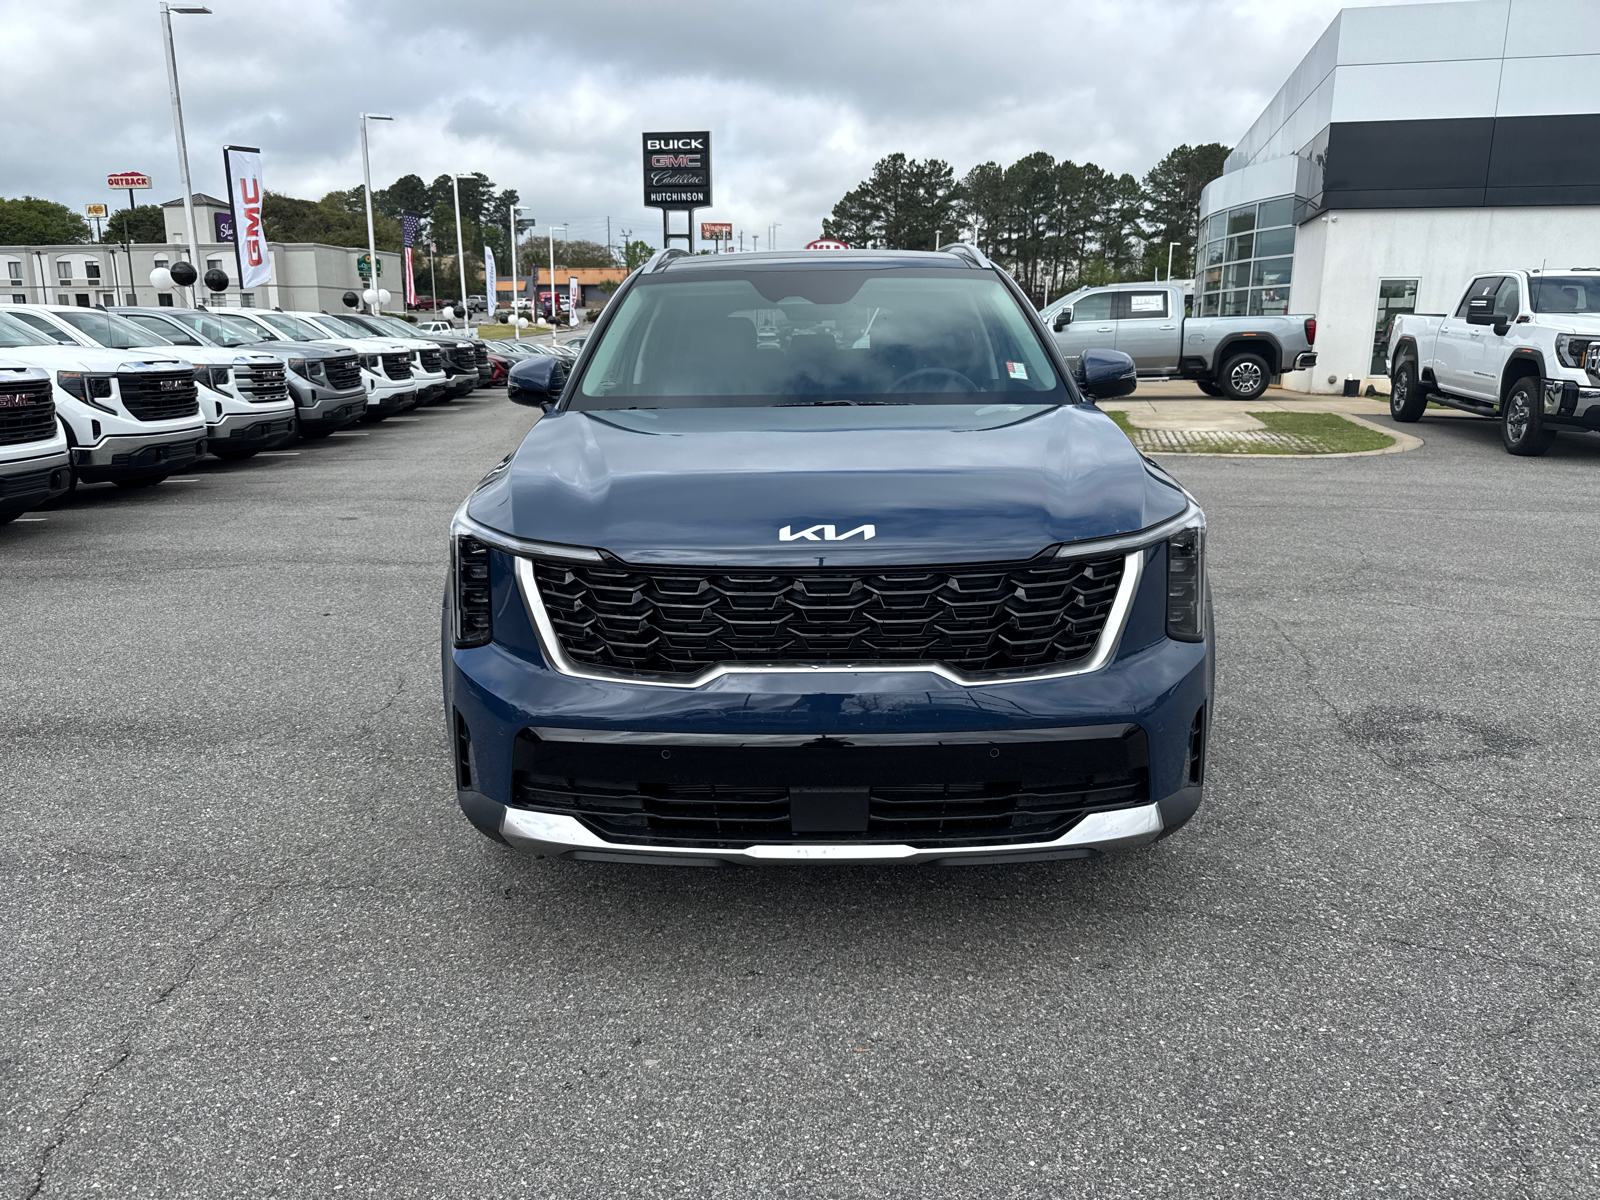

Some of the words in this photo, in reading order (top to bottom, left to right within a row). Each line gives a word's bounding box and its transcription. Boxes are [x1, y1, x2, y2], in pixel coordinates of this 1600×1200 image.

[647, 139, 704, 150] BUICK
[651, 155, 701, 168] GMC
[107, 178, 148, 186] OUTBACK
[651, 170, 703, 187] Cadillac
[650, 192, 704, 202] HUTCHINSON
[240, 178, 263, 267] GMC
[0, 393, 37, 407] GMC
[779, 524, 876, 542] KIA
